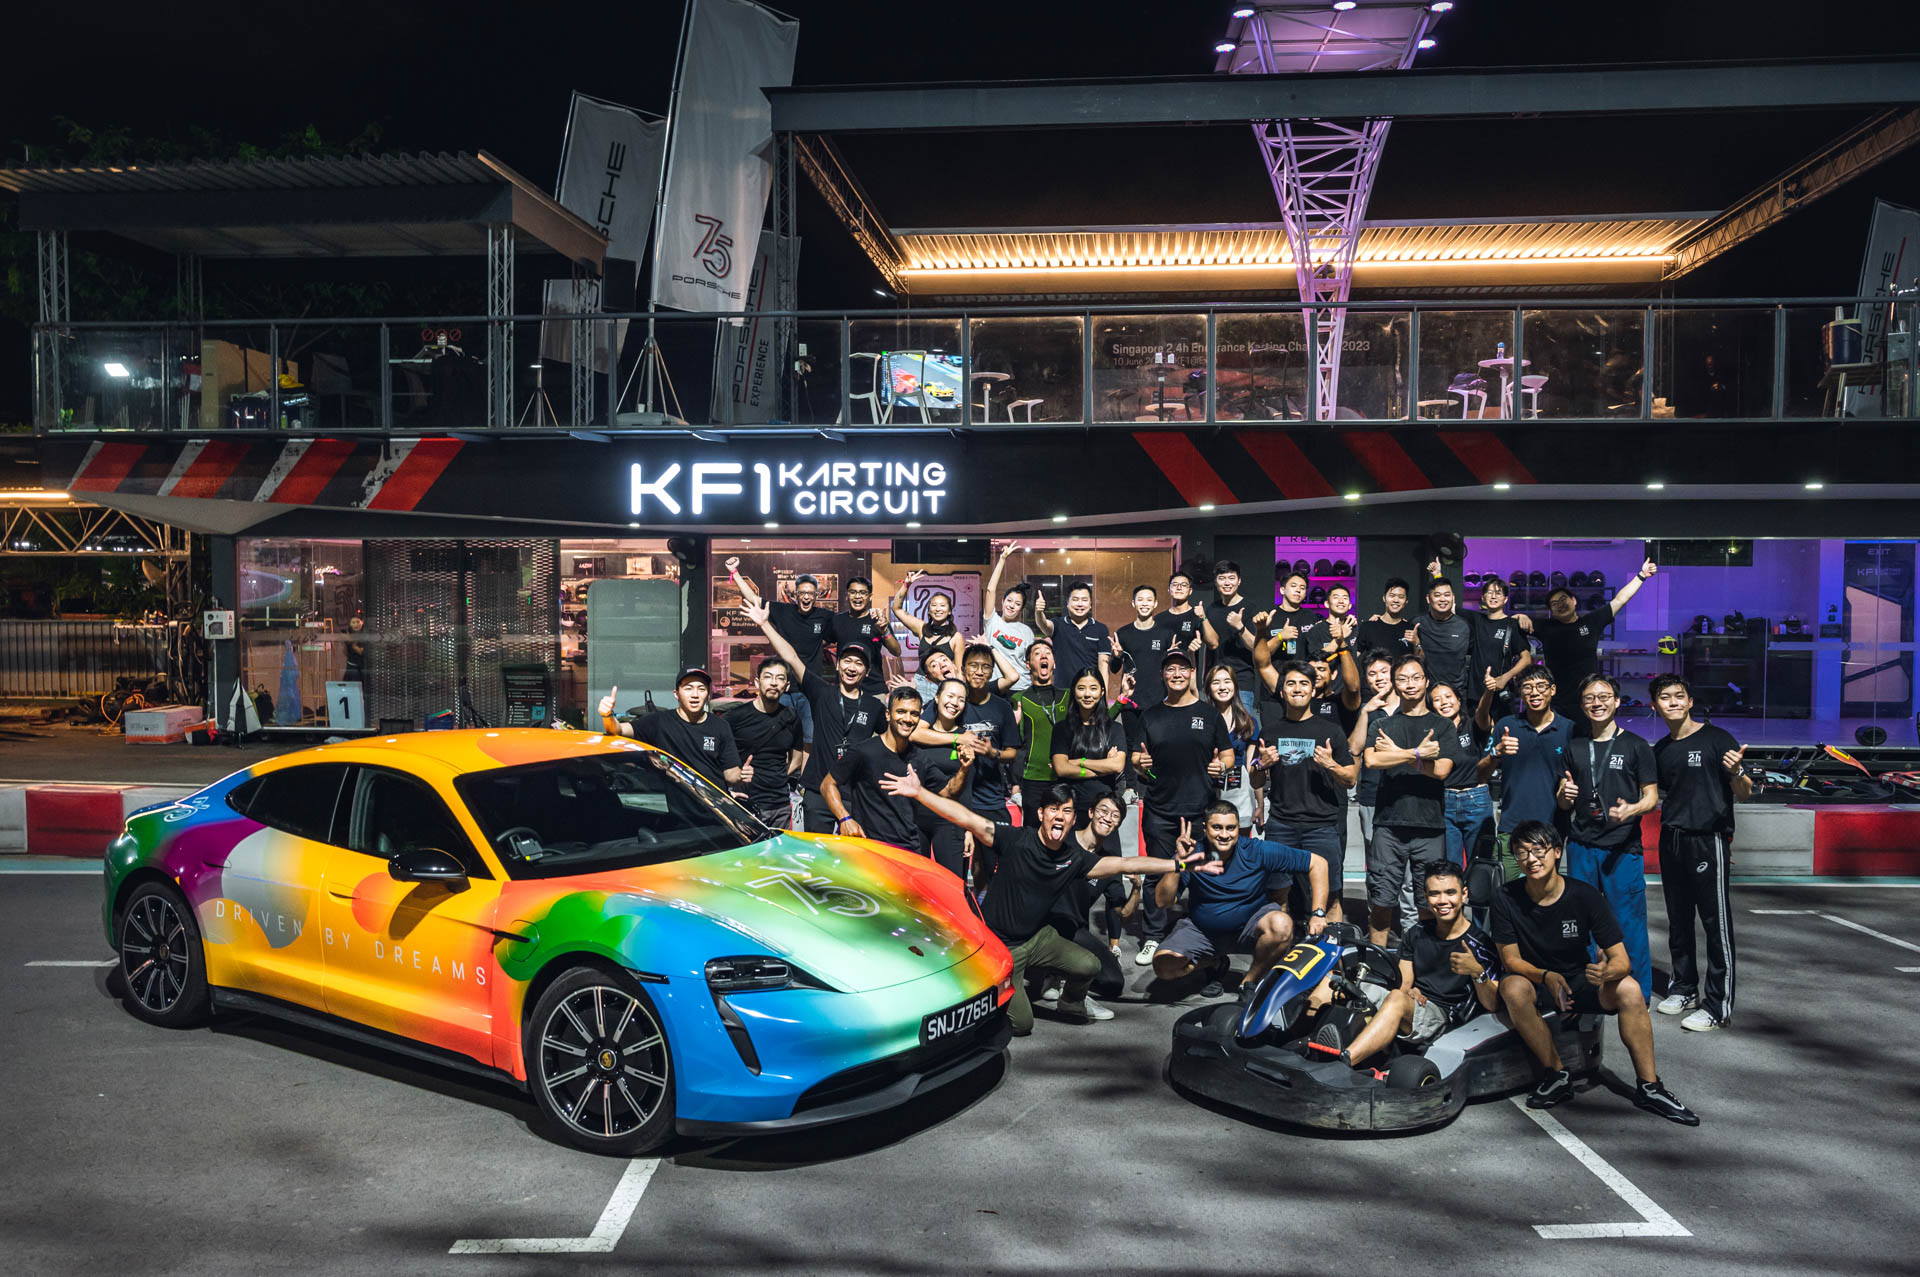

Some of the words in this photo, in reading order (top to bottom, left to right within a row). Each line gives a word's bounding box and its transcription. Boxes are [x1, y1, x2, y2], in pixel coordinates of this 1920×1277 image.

[596, 141, 626, 237] SCHE
[692, 213, 733, 279] 75
[672, 274, 741, 299] PORSCHE
[1112, 343, 1164, 356] Singapore
[1166, 343, 1189, 353] 2.4h
[1191, 342, 1246, 353] Enrance
[1342, 341, 1371, 351] 2023
[750, 338, 769, 407] EXPERIENCE
[630, 463, 771, 515] KF1
[779, 462, 947, 486] KARTING
[793, 490, 947, 515] CIRCUIT
[339, 697, 350, 720] 1
[744, 873, 880, 918] 75
[216, 901, 303, 936] DRIVEN
[325, 928, 351, 950] BY
[375, 941, 486, 985] DREAMS
[1283, 949, 1303, 962] 5
